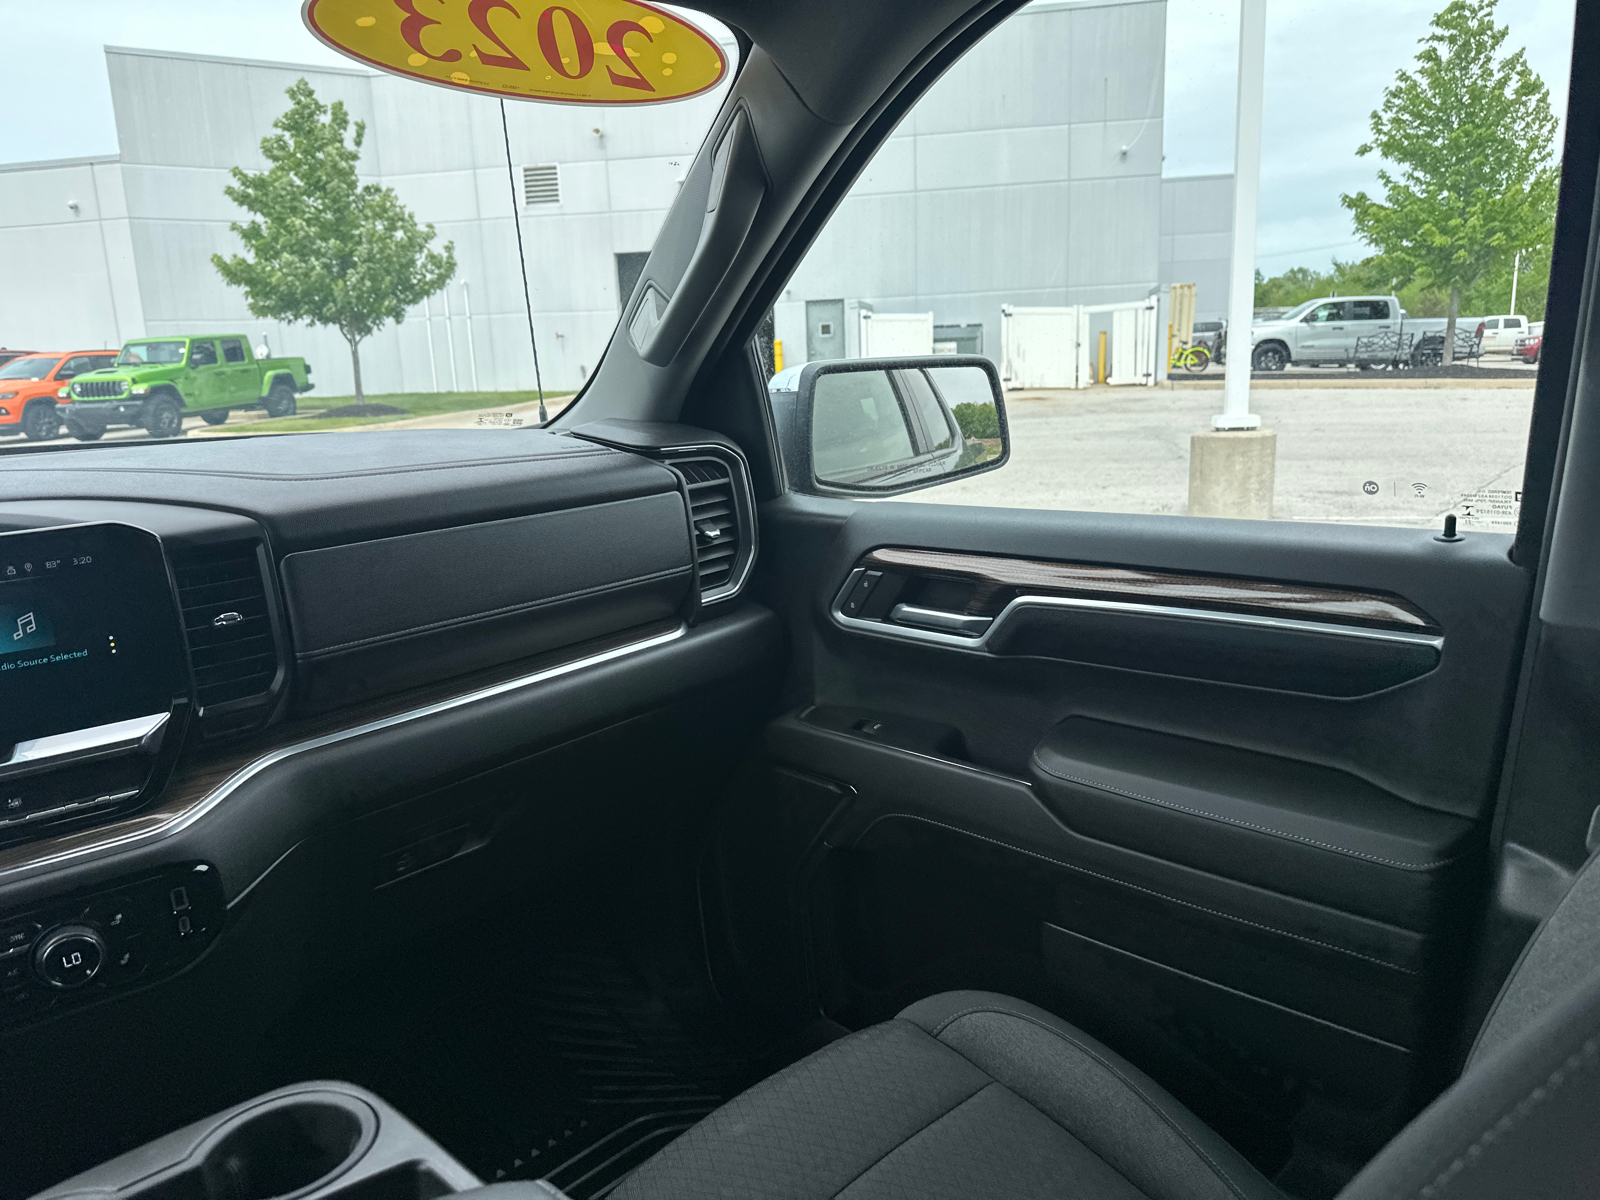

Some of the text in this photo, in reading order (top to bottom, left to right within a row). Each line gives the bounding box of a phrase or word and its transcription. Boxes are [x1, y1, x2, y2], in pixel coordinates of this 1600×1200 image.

[72, 555, 92, 566] 3:20
[0, 648, 89, 671] dio Source Selected
[9, 932, 26, 943] SYNC
